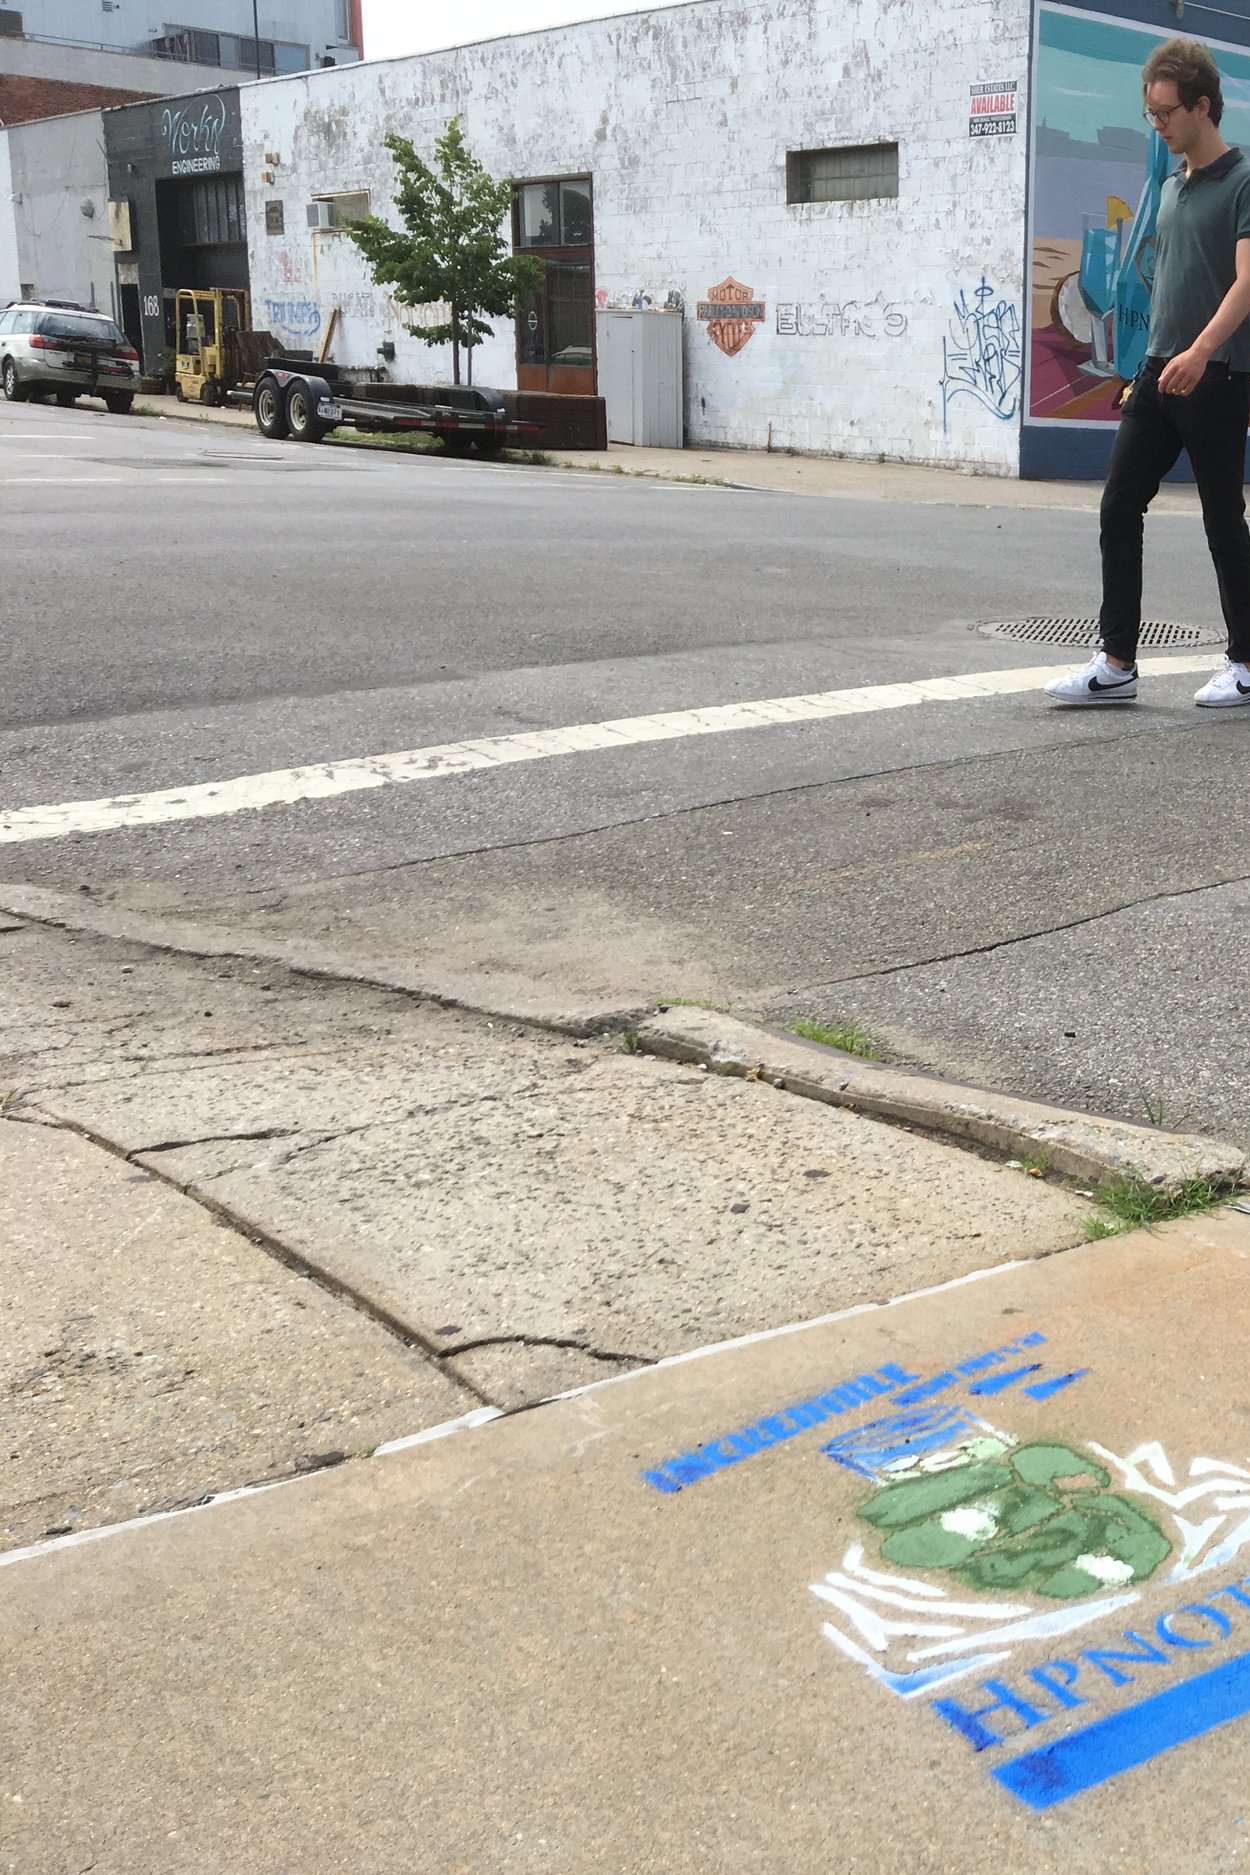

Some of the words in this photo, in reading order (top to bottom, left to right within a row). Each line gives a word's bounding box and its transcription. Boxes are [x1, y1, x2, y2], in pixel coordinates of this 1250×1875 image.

[984, 82, 1004, 93] ESTATES
[970, 93, 1015, 115] AVAILABLE
[970, 120, 1015, 136] 347-922-8123
[172, 155, 221, 175] ENGINEERING
[711, 283, 749, 301] MOTOR
[143, 294, 160, 316] 168
